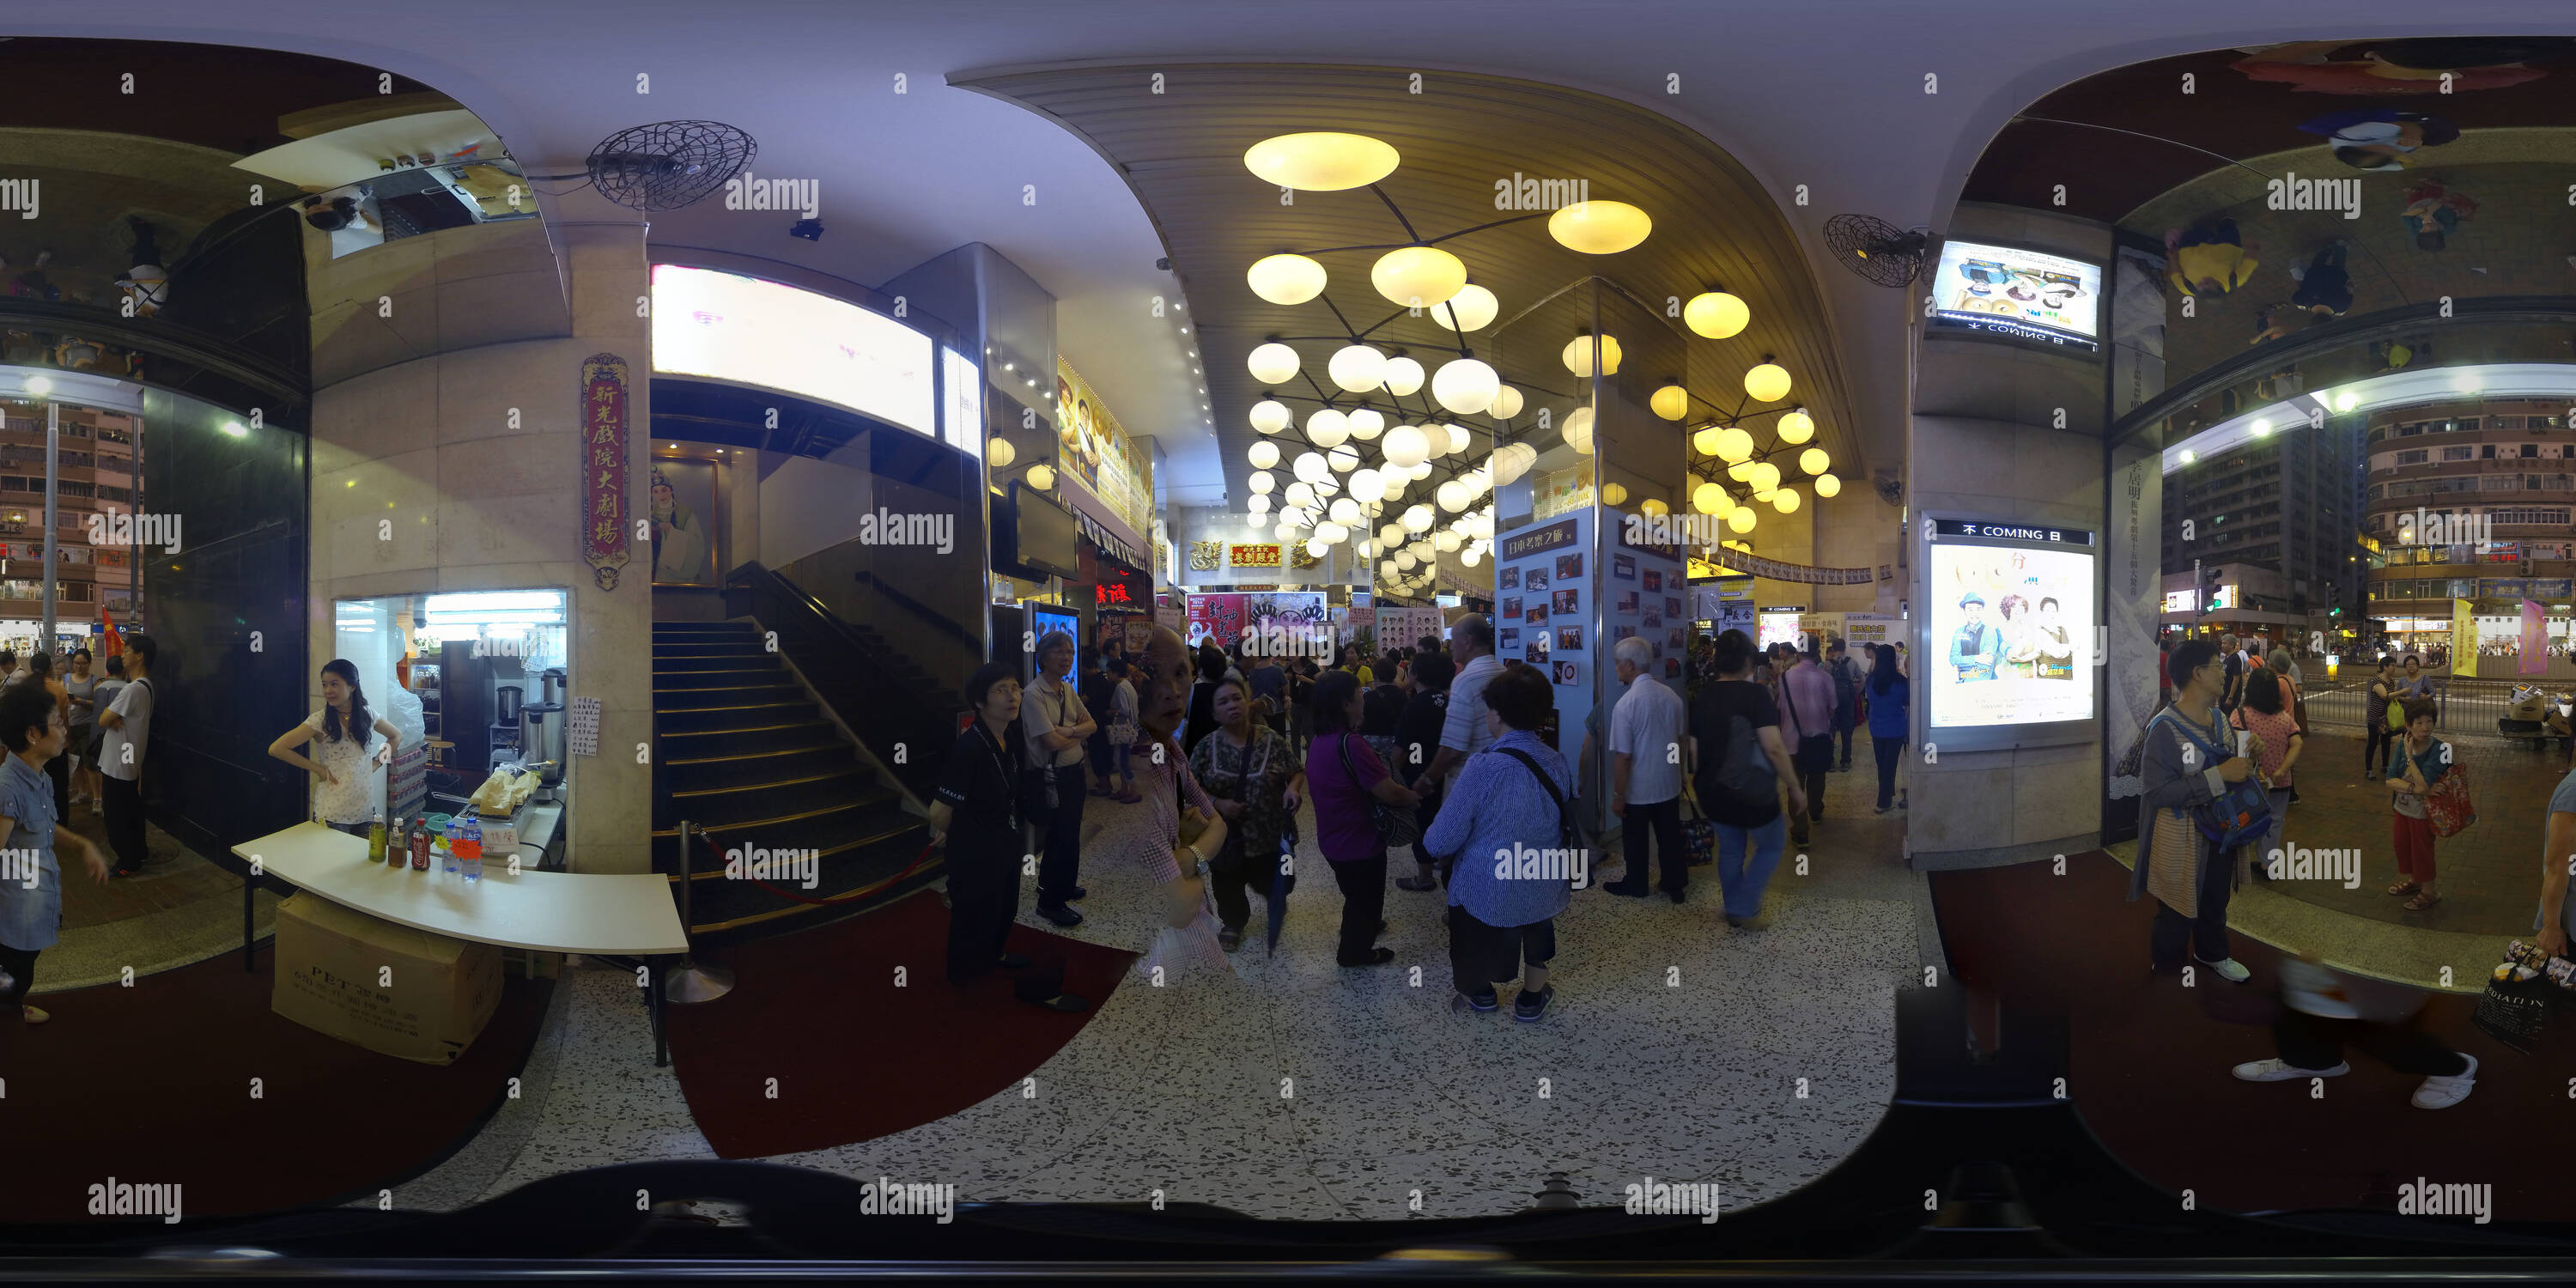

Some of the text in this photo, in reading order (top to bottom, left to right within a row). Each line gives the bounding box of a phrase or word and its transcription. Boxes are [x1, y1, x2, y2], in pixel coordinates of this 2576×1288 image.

[592, 386, 619, 545] 新光戲院大劇場
[1509, 528, 1564, 556] 日本考察之旅
[1963, 525, 2061, 542] 不 COMING 日
